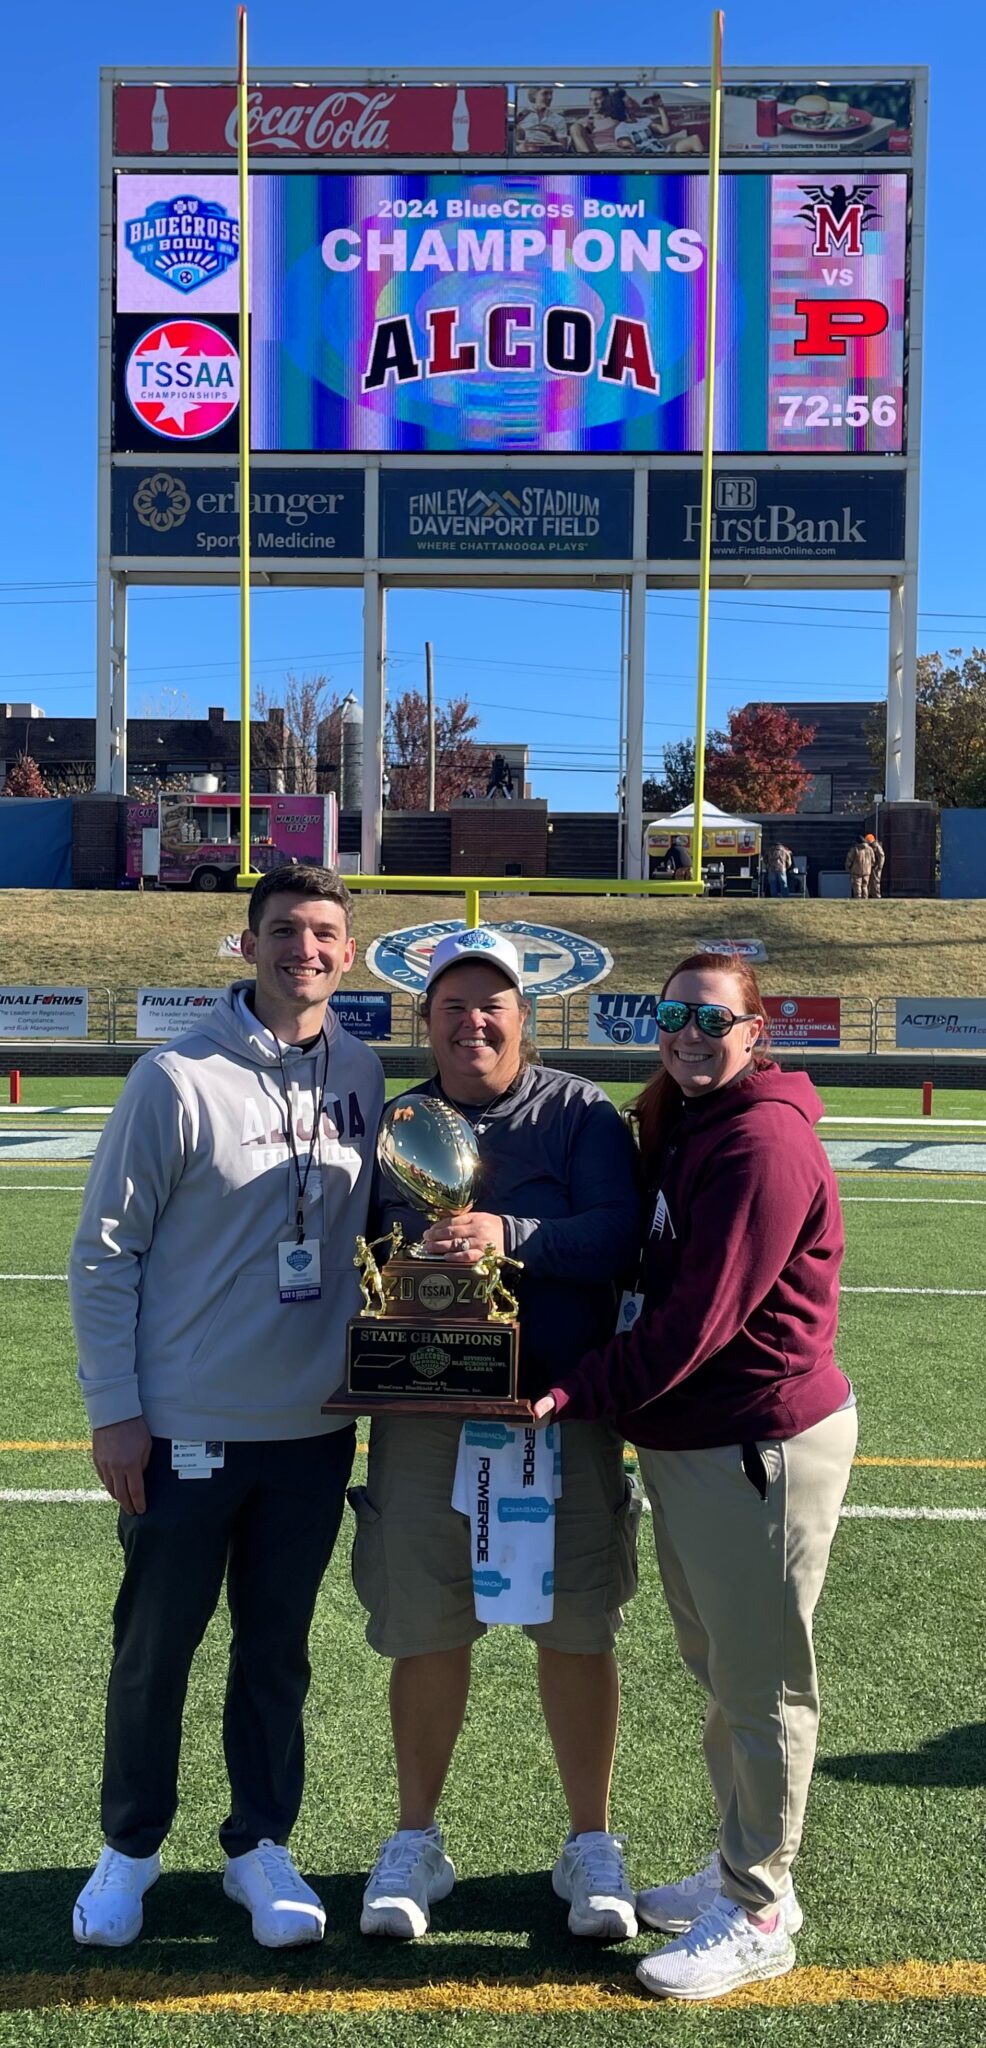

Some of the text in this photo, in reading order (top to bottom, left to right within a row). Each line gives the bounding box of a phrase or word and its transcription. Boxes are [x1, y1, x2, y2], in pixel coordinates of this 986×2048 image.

[225, 91, 396, 149] Coca-Cola
[378, 199, 645, 219] 2024 BlueCross Bowl
[130, 215, 240, 245] BLUECROSS
[813, 204, 864, 257] M
[159, 238, 215, 252] BOWL
[321, 229, 704, 272] CHAMPIONS
[794, 299, 889, 356] P
[362, 303, 661, 395] ALCOA
[136, 361, 234, 388] TSSAA
[140, 391, 228, 399] CHAMPIONSHIPS
[778, 395, 897, 428] 72:56
[196, 481, 345, 527] erlanger
[409, 487, 600, 516] FINLEY STADIUM
[720, 482, 753, 506] FB
[409, 516, 600, 537] DAVENPORT FIELD
[682, 505, 867, 543] FirstBank
[196, 532, 336, 551] Sport Medicine
[417, 542, 456, 550] WHERE
[460, 542, 546, 551] CHATTANOOGA
[713, 547, 836, 556] www.FirstBankOnline.com
[276, 815, 320, 824] WINDY CITY
[392, 969, 423, 983] OF
[0, 993, 84, 1005] INALFORMS
[421, 1284, 451, 1297] TSSAA
[457, 1279, 489, 1304] 24
[361, 1330, 502, 1346] STATE CHAMPIONS
[477, 1456, 491, 1564] POWERADE
